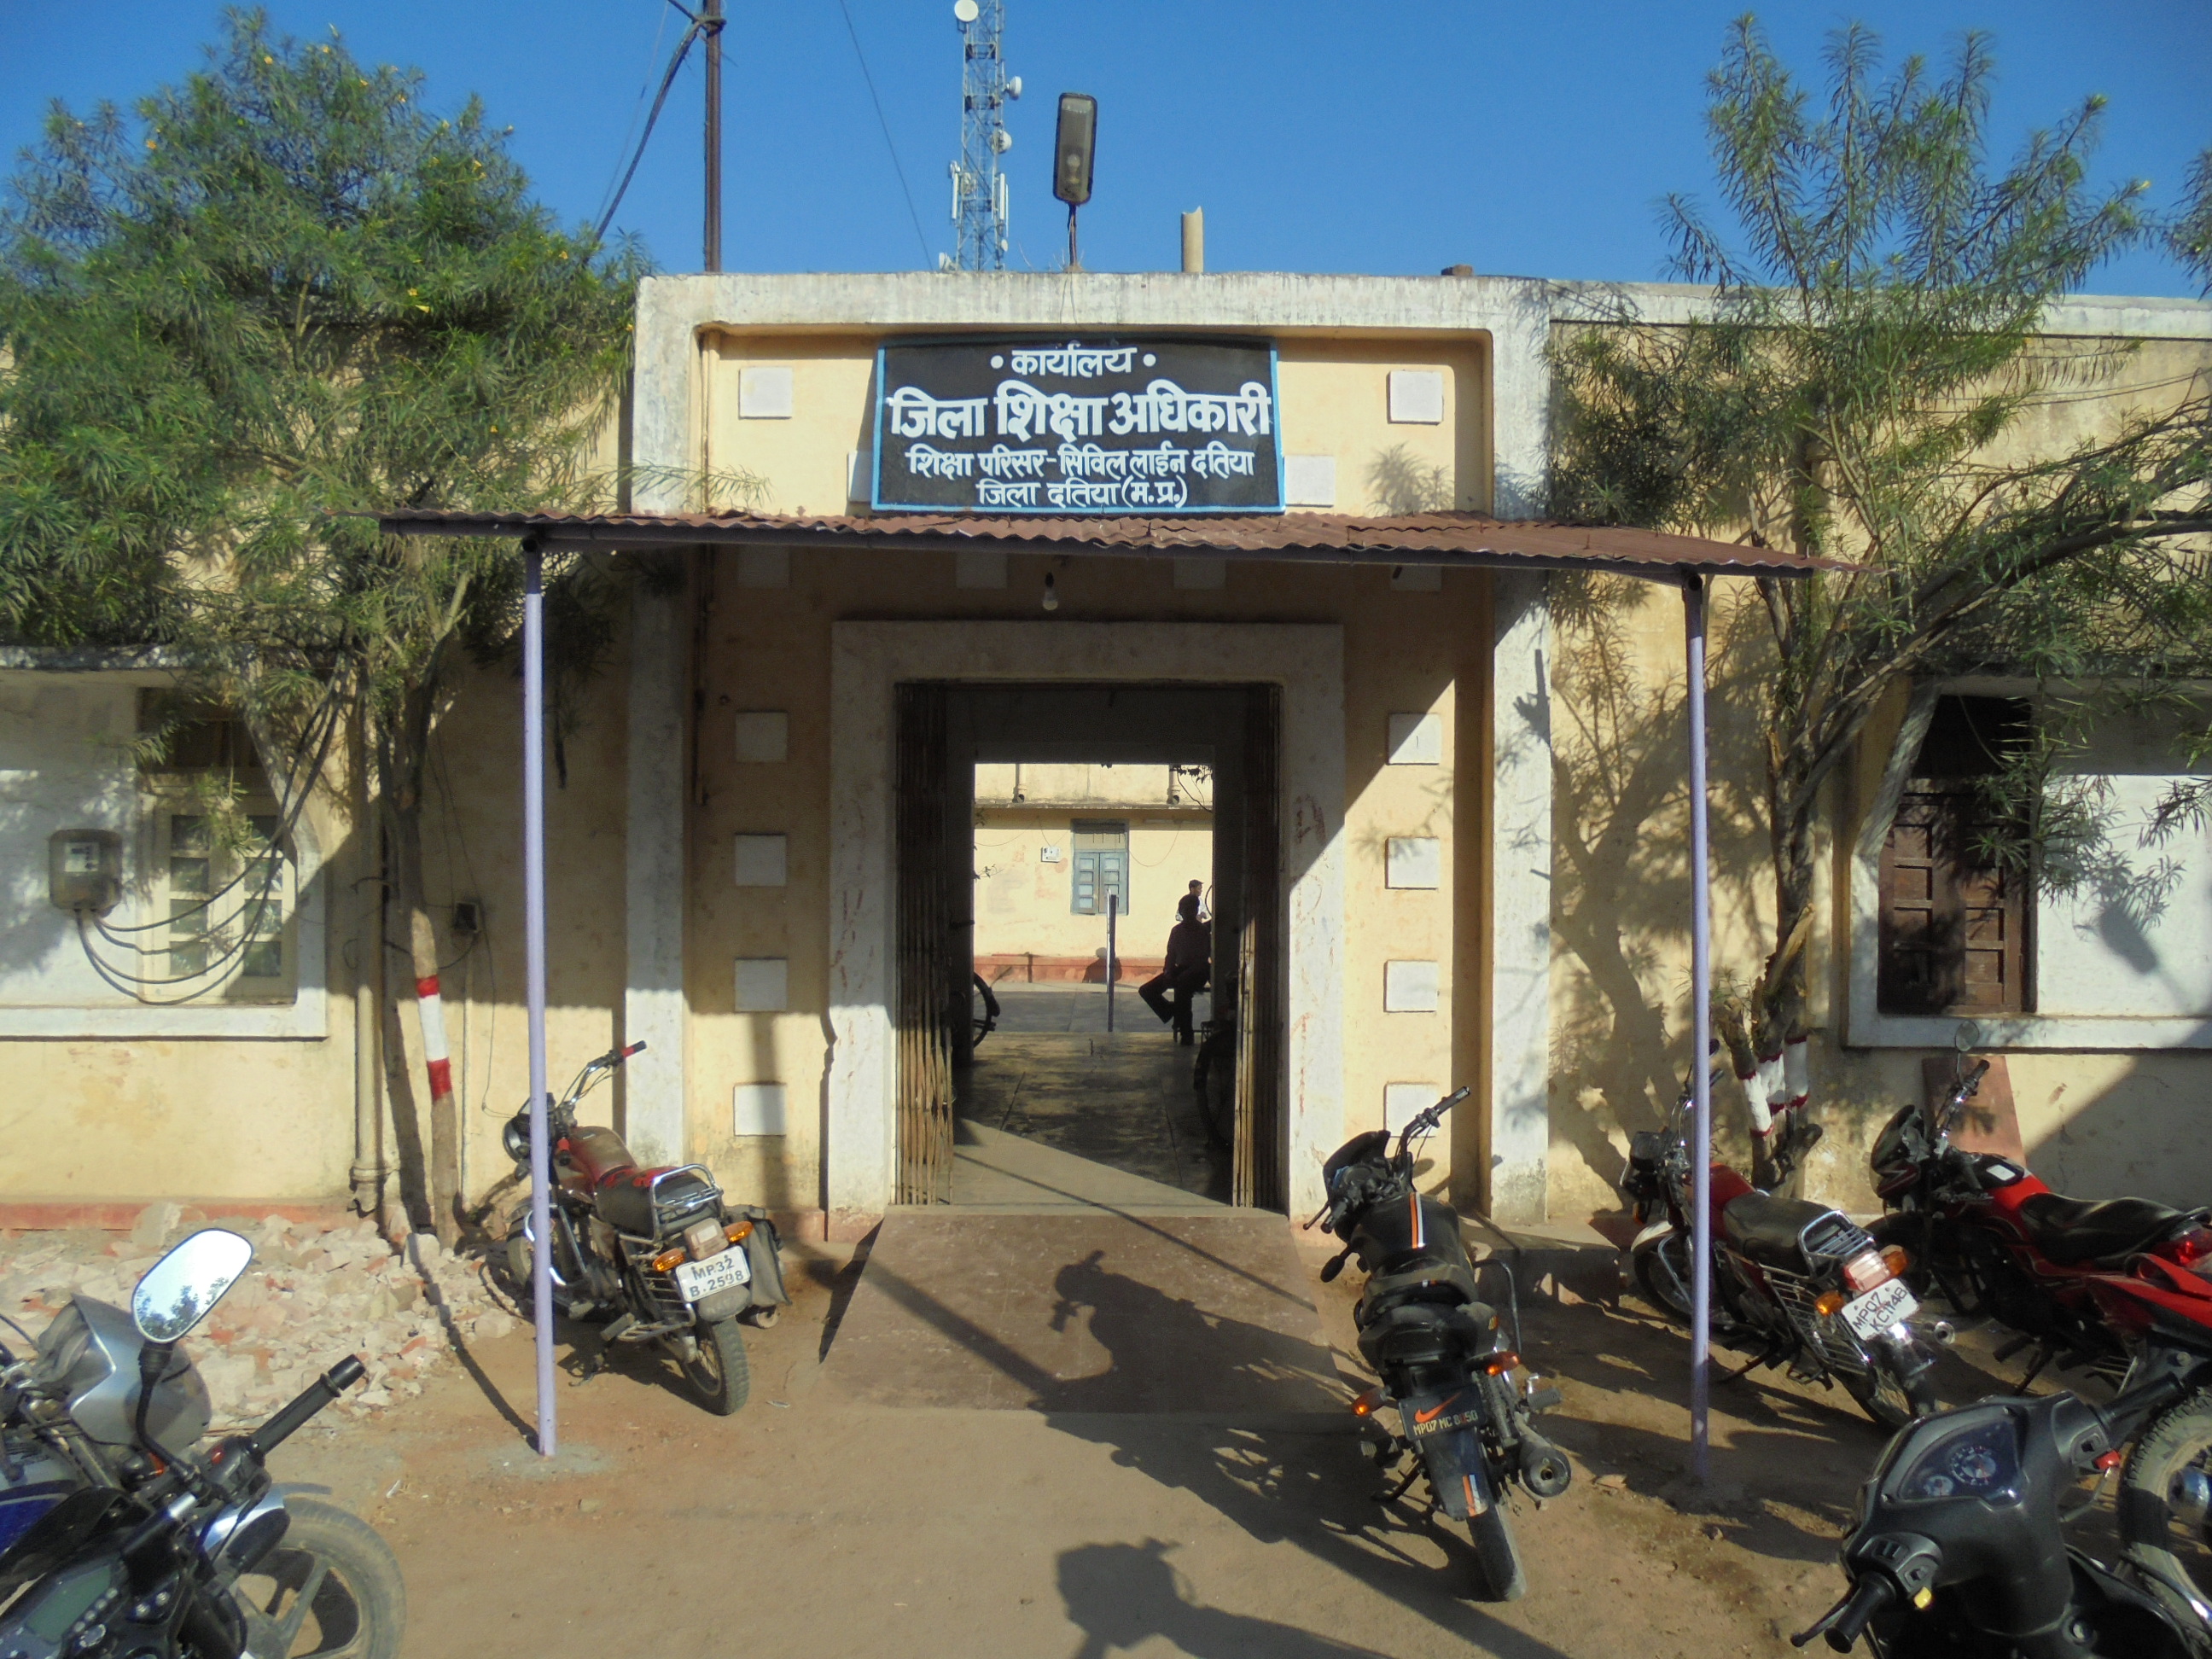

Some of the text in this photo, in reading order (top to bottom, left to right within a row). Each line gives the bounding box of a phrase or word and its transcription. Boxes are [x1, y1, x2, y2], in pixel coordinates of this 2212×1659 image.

[1011, 341, 1138, 377] कार्यालय
[887, 379, 1272, 443] जिला शिक्षा अधिकारी
[905, 443, 975, 480] शिक्षा
[1129, 440, 1190, 480] लाईन
[1191, 440, 1254, 479] दतिया
[975, 478, 1041, 507] जिला
[1047, 476, 1121, 508] दतिया
[1853, 1291, 1883, 1330] MP07
[1412, 1419, 1437, 1435] MP07
[1438, 1416, 1452, 1429] MC
